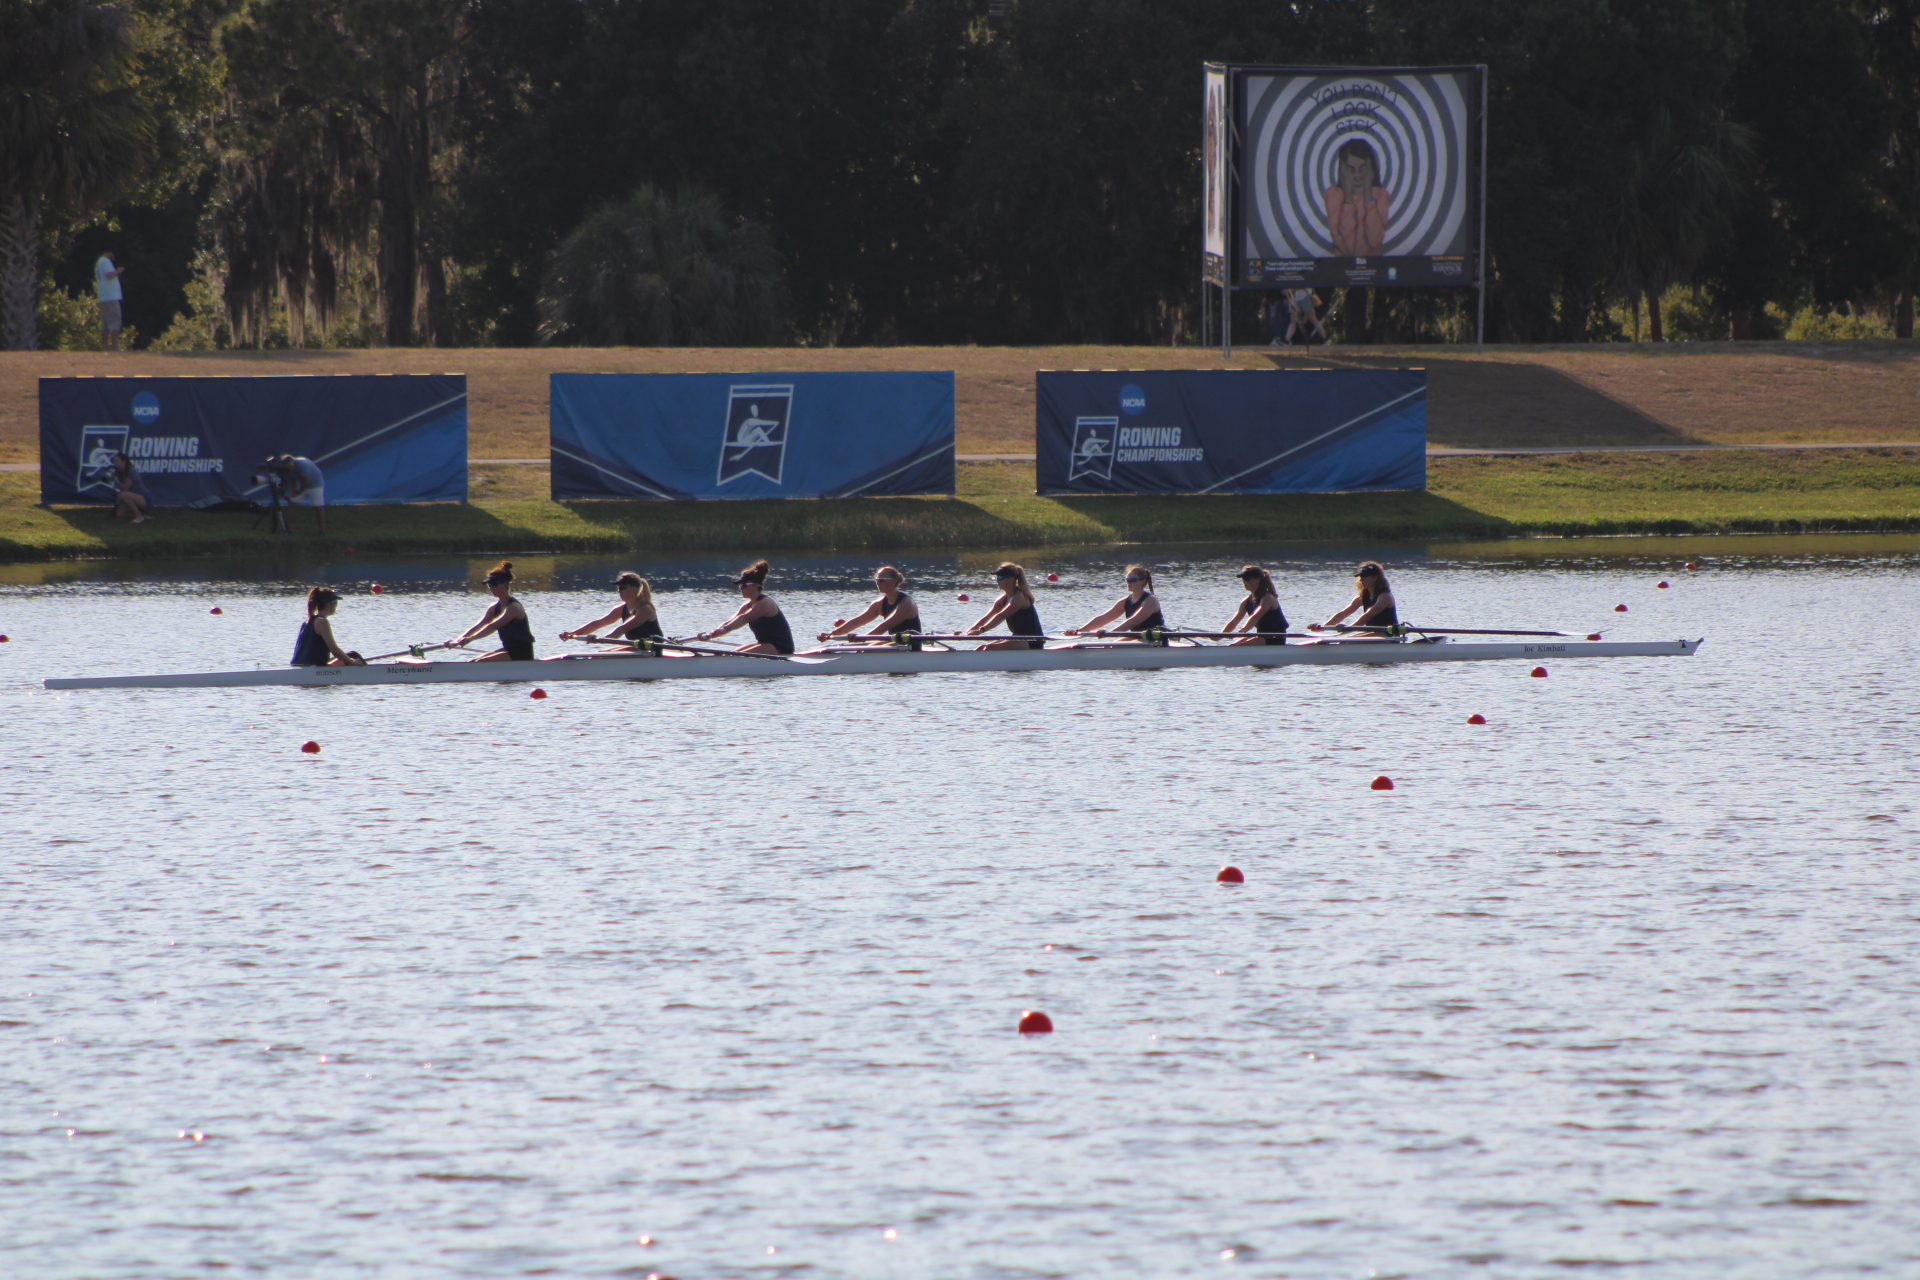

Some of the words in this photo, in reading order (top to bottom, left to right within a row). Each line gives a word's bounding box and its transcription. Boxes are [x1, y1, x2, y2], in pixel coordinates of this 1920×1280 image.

[1310, 84, 1346, 106] YOU
[1352, 83, 1401, 106] DON'T
[1331, 101, 1381, 120] LOOK
[1336, 118, 1378, 135] SICK
[133, 406, 160, 416] NCAA
[1122, 398, 1146, 407] NCAA
[1119, 427, 1182, 447] ROWING
[129, 437, 200, 458] ROWING
[1116, 448, 1204, 462] CHAMPIONSHIPS
[386, 666, 433, 677] Mercyhurst
